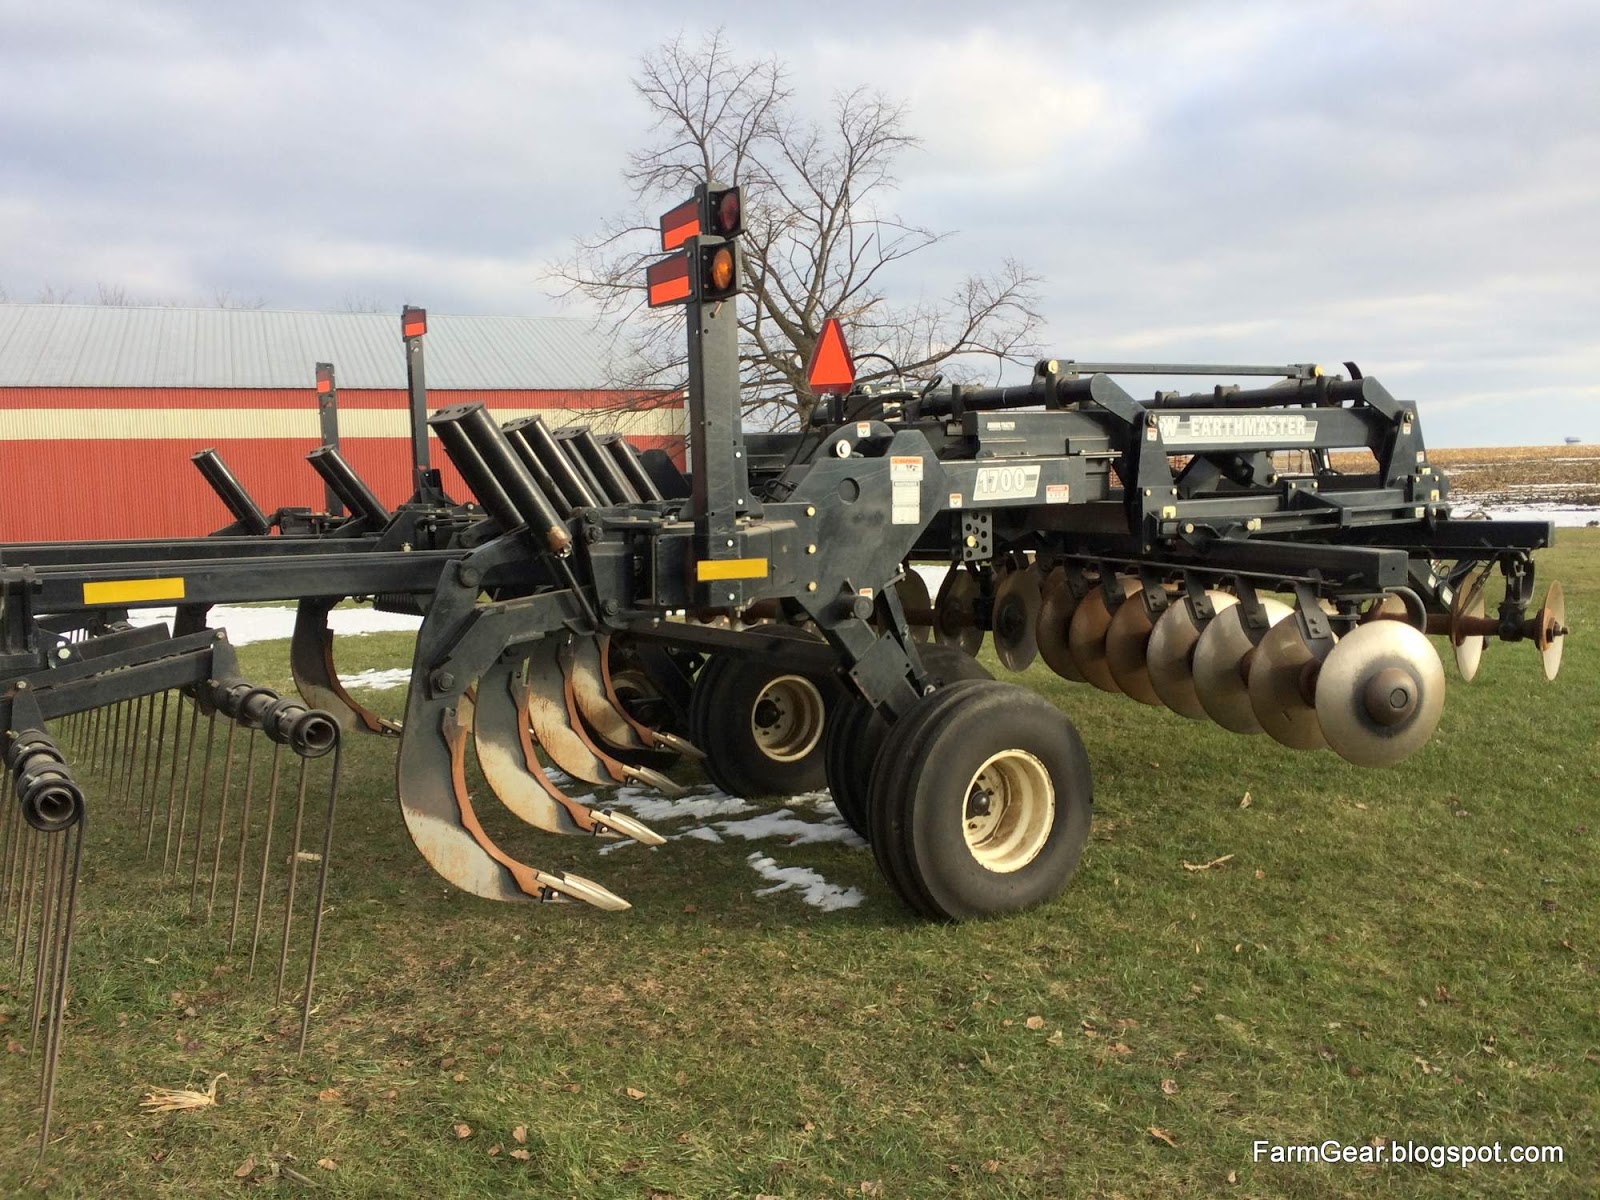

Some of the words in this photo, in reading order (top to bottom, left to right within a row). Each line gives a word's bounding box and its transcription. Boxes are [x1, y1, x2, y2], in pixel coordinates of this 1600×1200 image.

[1160, 417, 1179, 437] W
[1190, 416, 1306, 437] EARTHMASTER
[978, 468, 1025, 493] 1700
